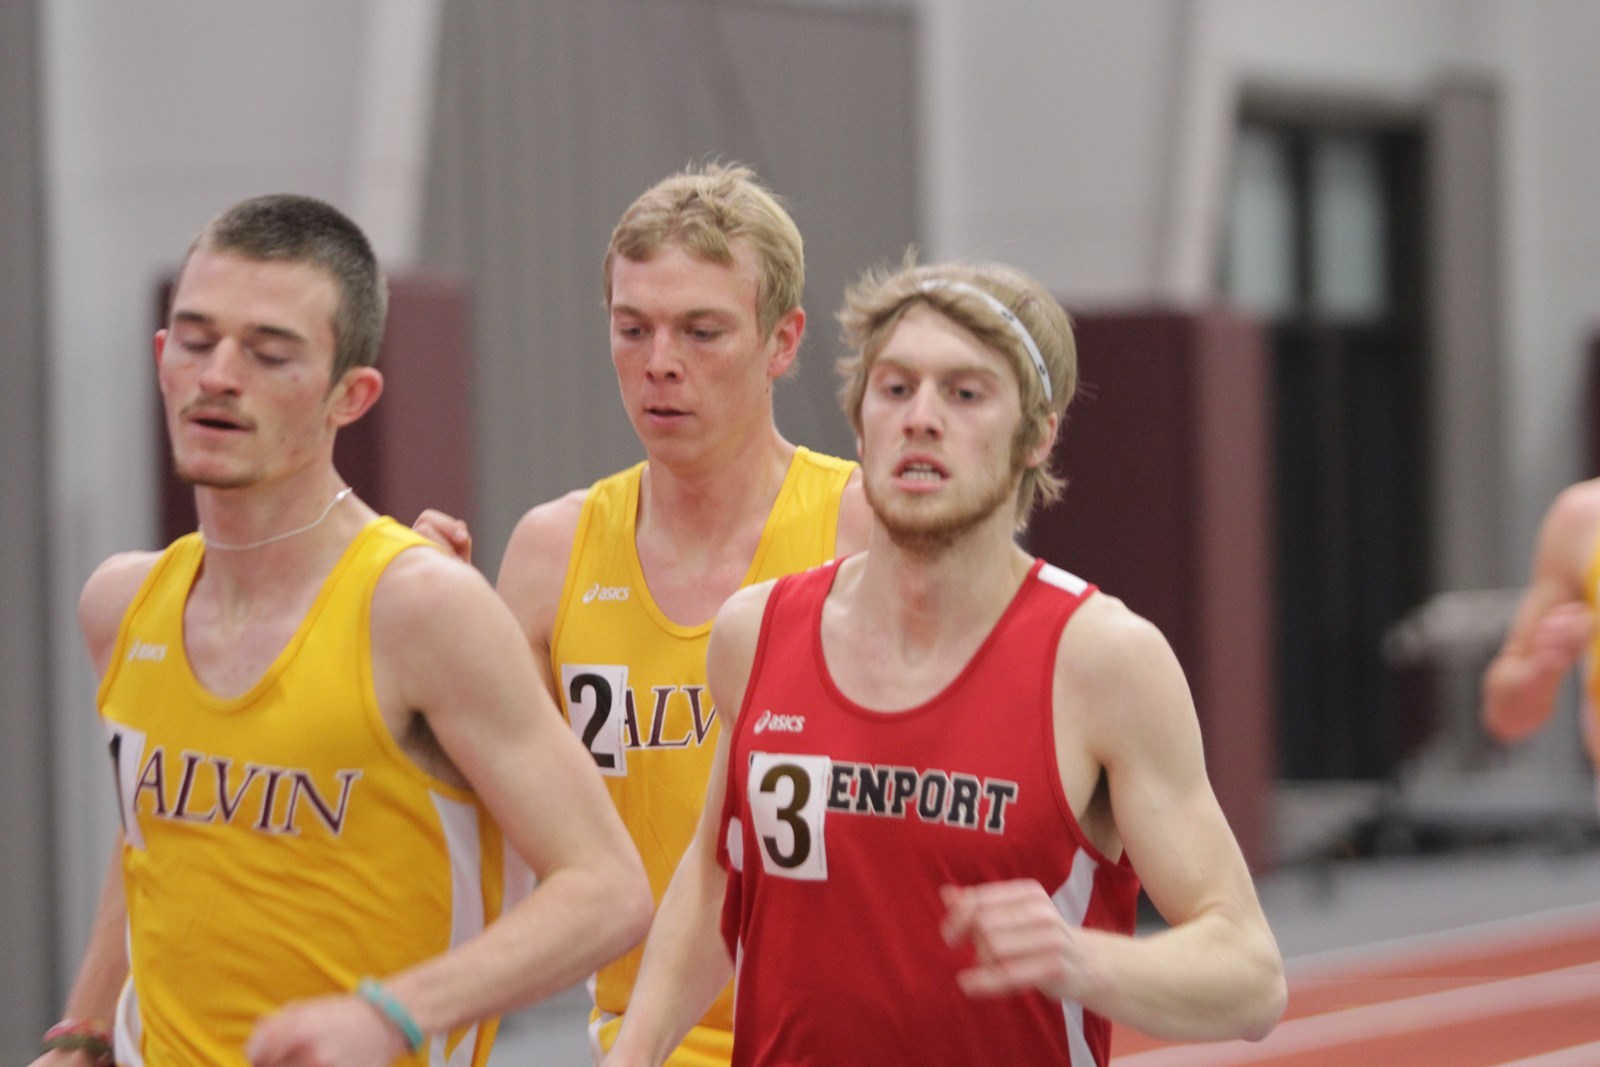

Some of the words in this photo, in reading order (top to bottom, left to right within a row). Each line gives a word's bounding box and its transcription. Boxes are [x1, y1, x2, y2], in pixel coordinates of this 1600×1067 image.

[569, 673, 615, 769] 2
[133, 747, 363, 838] ALVIN
[760, 764, 811, 870] 3
[827, 760, 1018, 834] ENPORT
